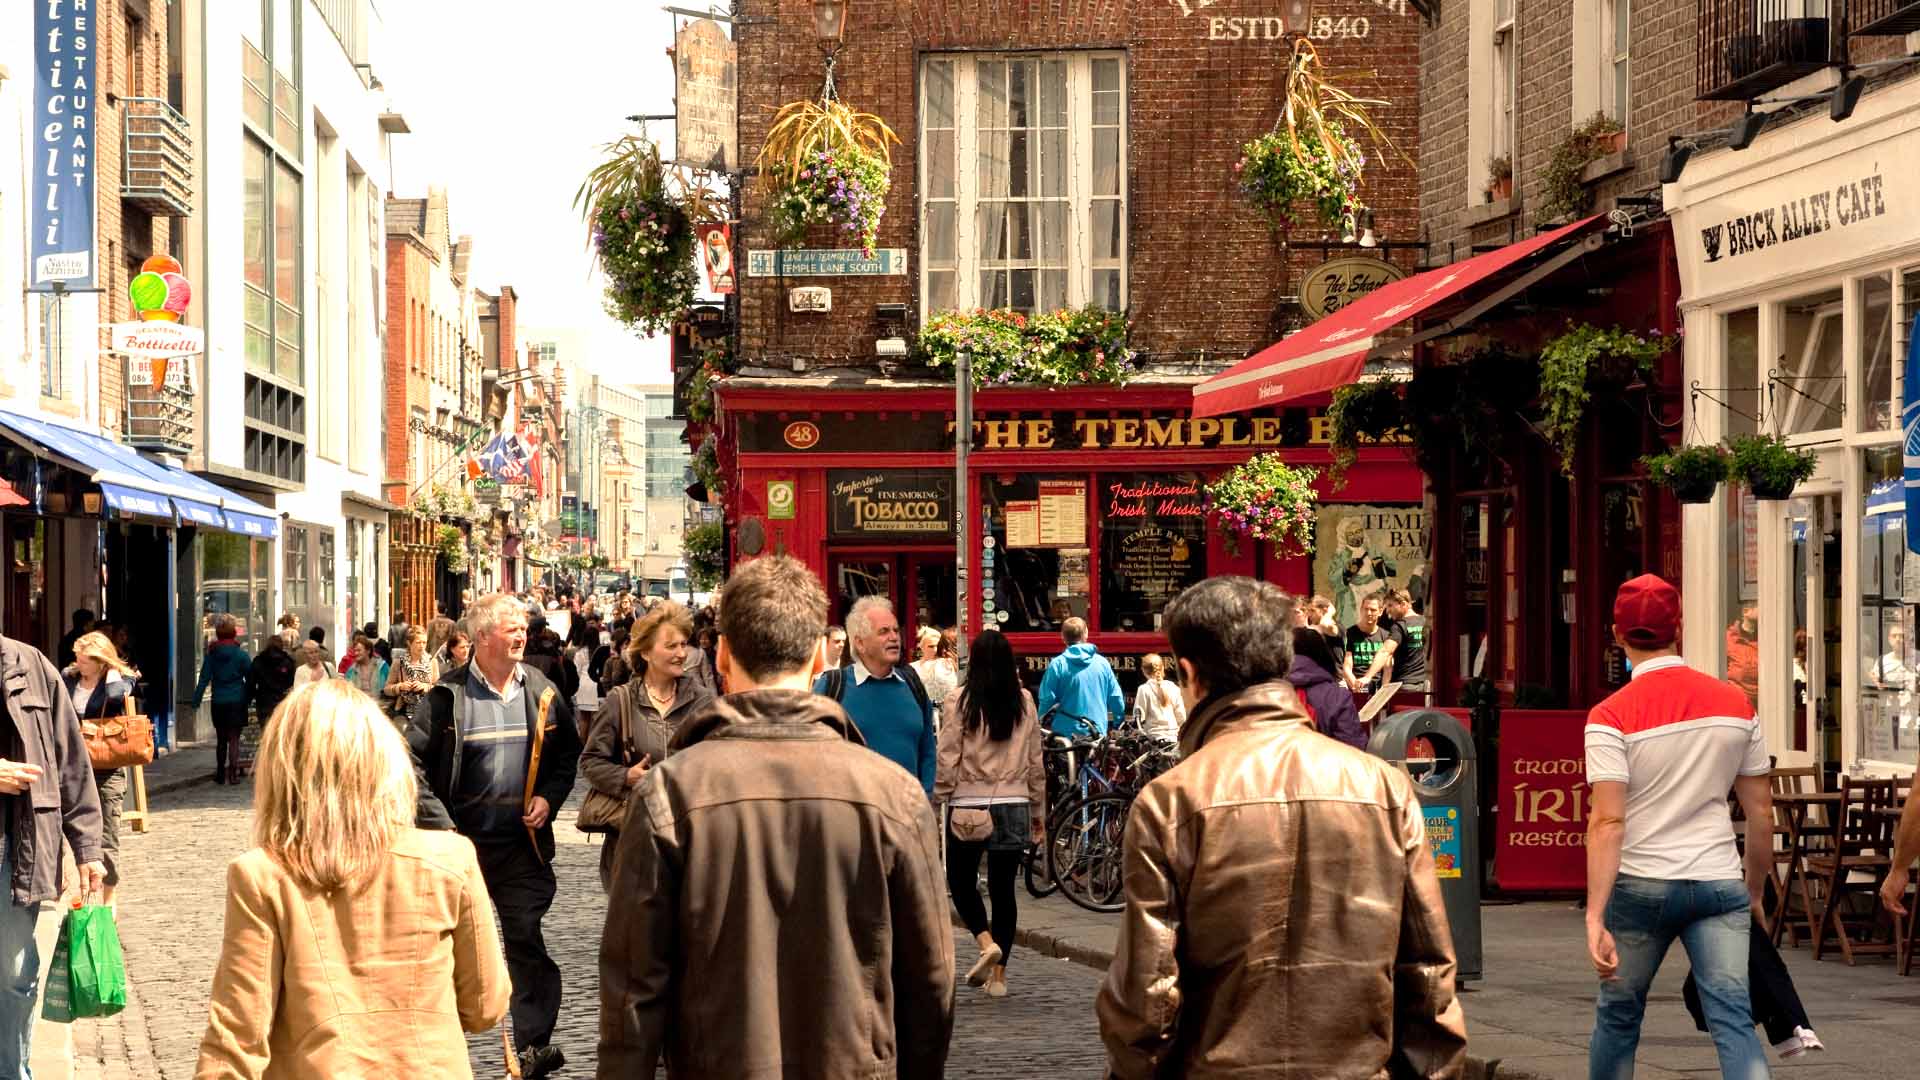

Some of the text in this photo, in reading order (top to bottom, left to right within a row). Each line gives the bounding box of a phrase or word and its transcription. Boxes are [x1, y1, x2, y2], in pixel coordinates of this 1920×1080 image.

[1209, 17, 1284, 40] ESTD
[72, 0, 88, 187] RESTAURANT
[1727, 161, 1886, 257] BRICK ALLEY CAFÉ
[782, 263, 882, 273] TEMPLE LANE SOUTH
[1325, 274, 1346, 294] The
[123, 335, 197, 352] Botticelli
[790, 427, 812, 442] 48
[1075, 417, 1283, 448] TEMPLE
[832, 474, 884, 497] Importers
[1110, 480, 1198, 499] Traditional
[898, 491, 938, 500] SMOKING
[846, 496, 939, 528] TOBACCO
[1107, 499, 1201, 517] Irish Music
[917, 521, 947, 530] Stock
[1122, 527, 1163, 546] TEMPLE
